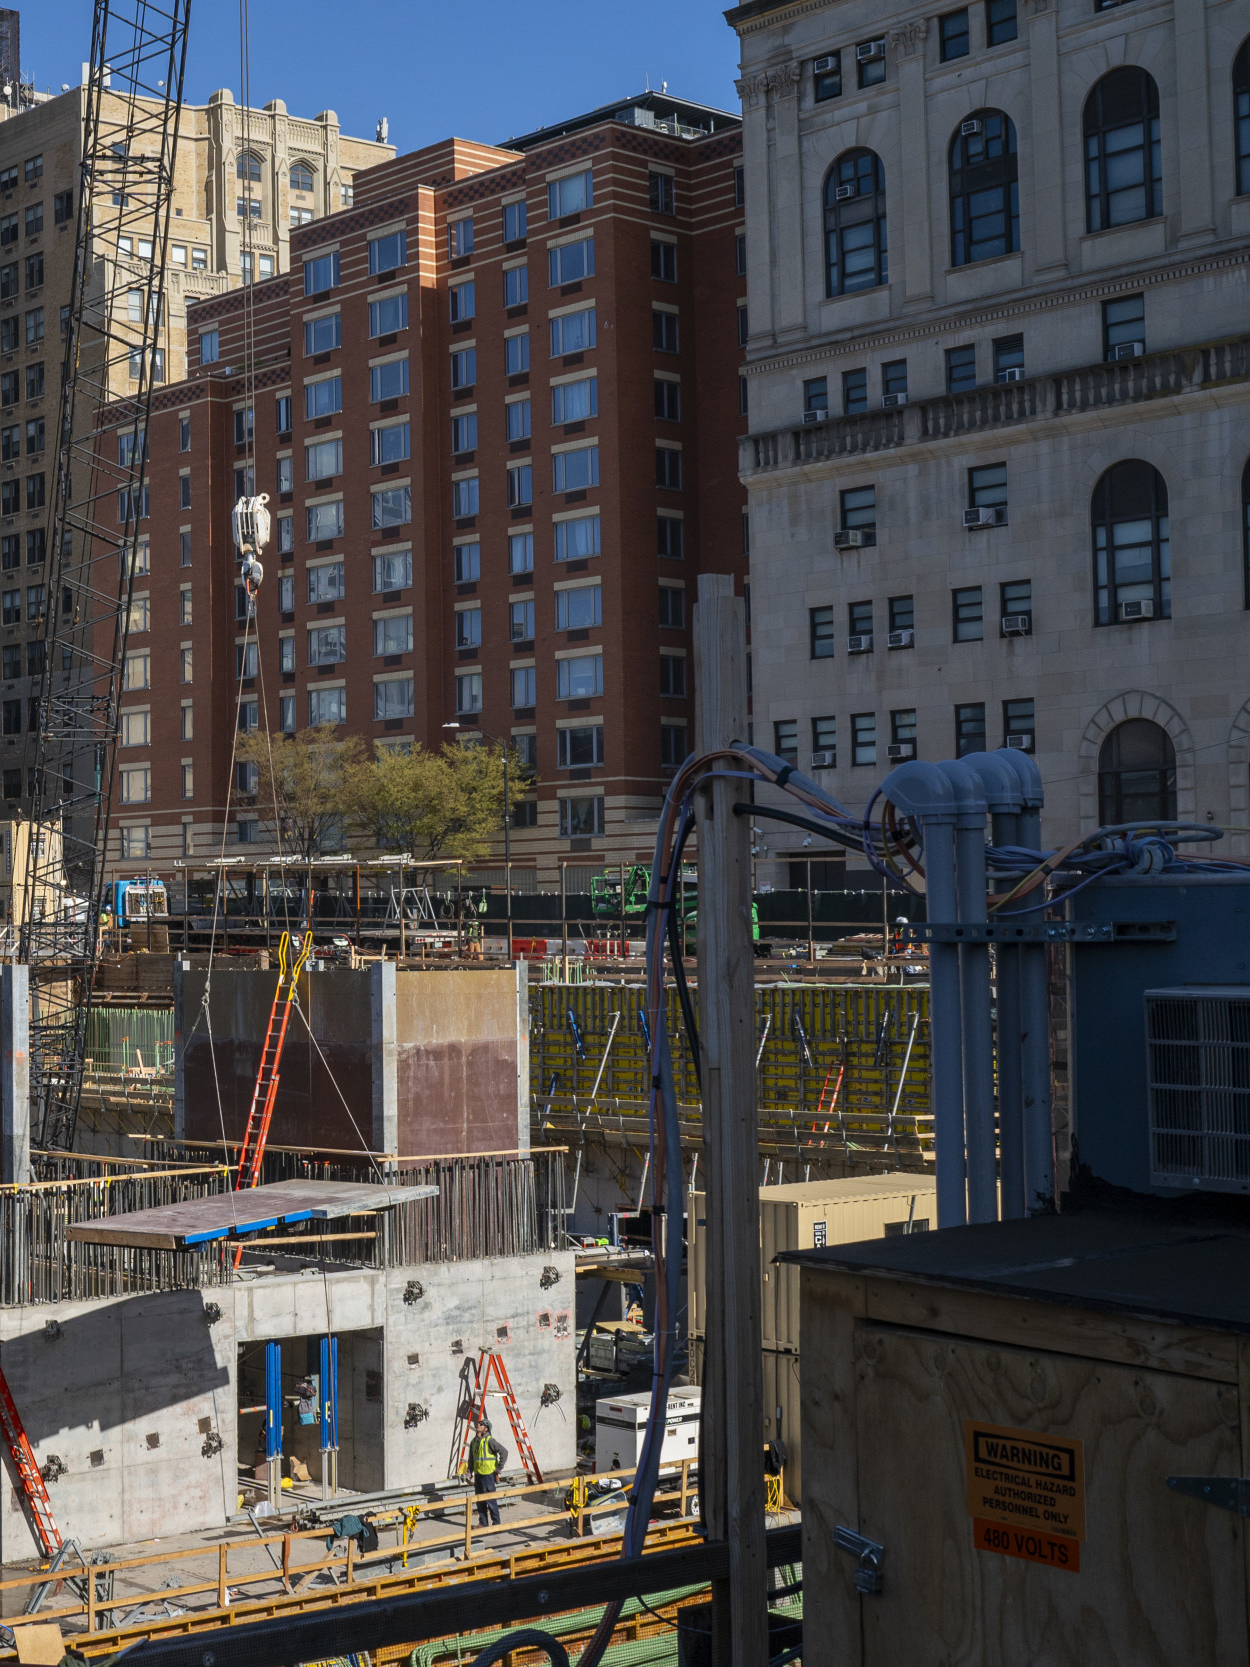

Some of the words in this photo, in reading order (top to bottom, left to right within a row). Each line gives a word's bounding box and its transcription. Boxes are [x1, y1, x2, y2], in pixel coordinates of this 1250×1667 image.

[985, 1440, 1062, 1472] WARNING
[974, 1467, 1032, 1488] ELECTRICAL
[1035, 1480, 1076, 1497] HAZARD
[994, 1485, 1056, 1507] AUTHORIZED
[982, 1496, 1040, 1518] PERSONNEL
[1043, 1510, 1069, 1525] ONLY
[983, 1527, 1010, 1550] 480
[1013, 1533, 1069, 1564] VOLTS
